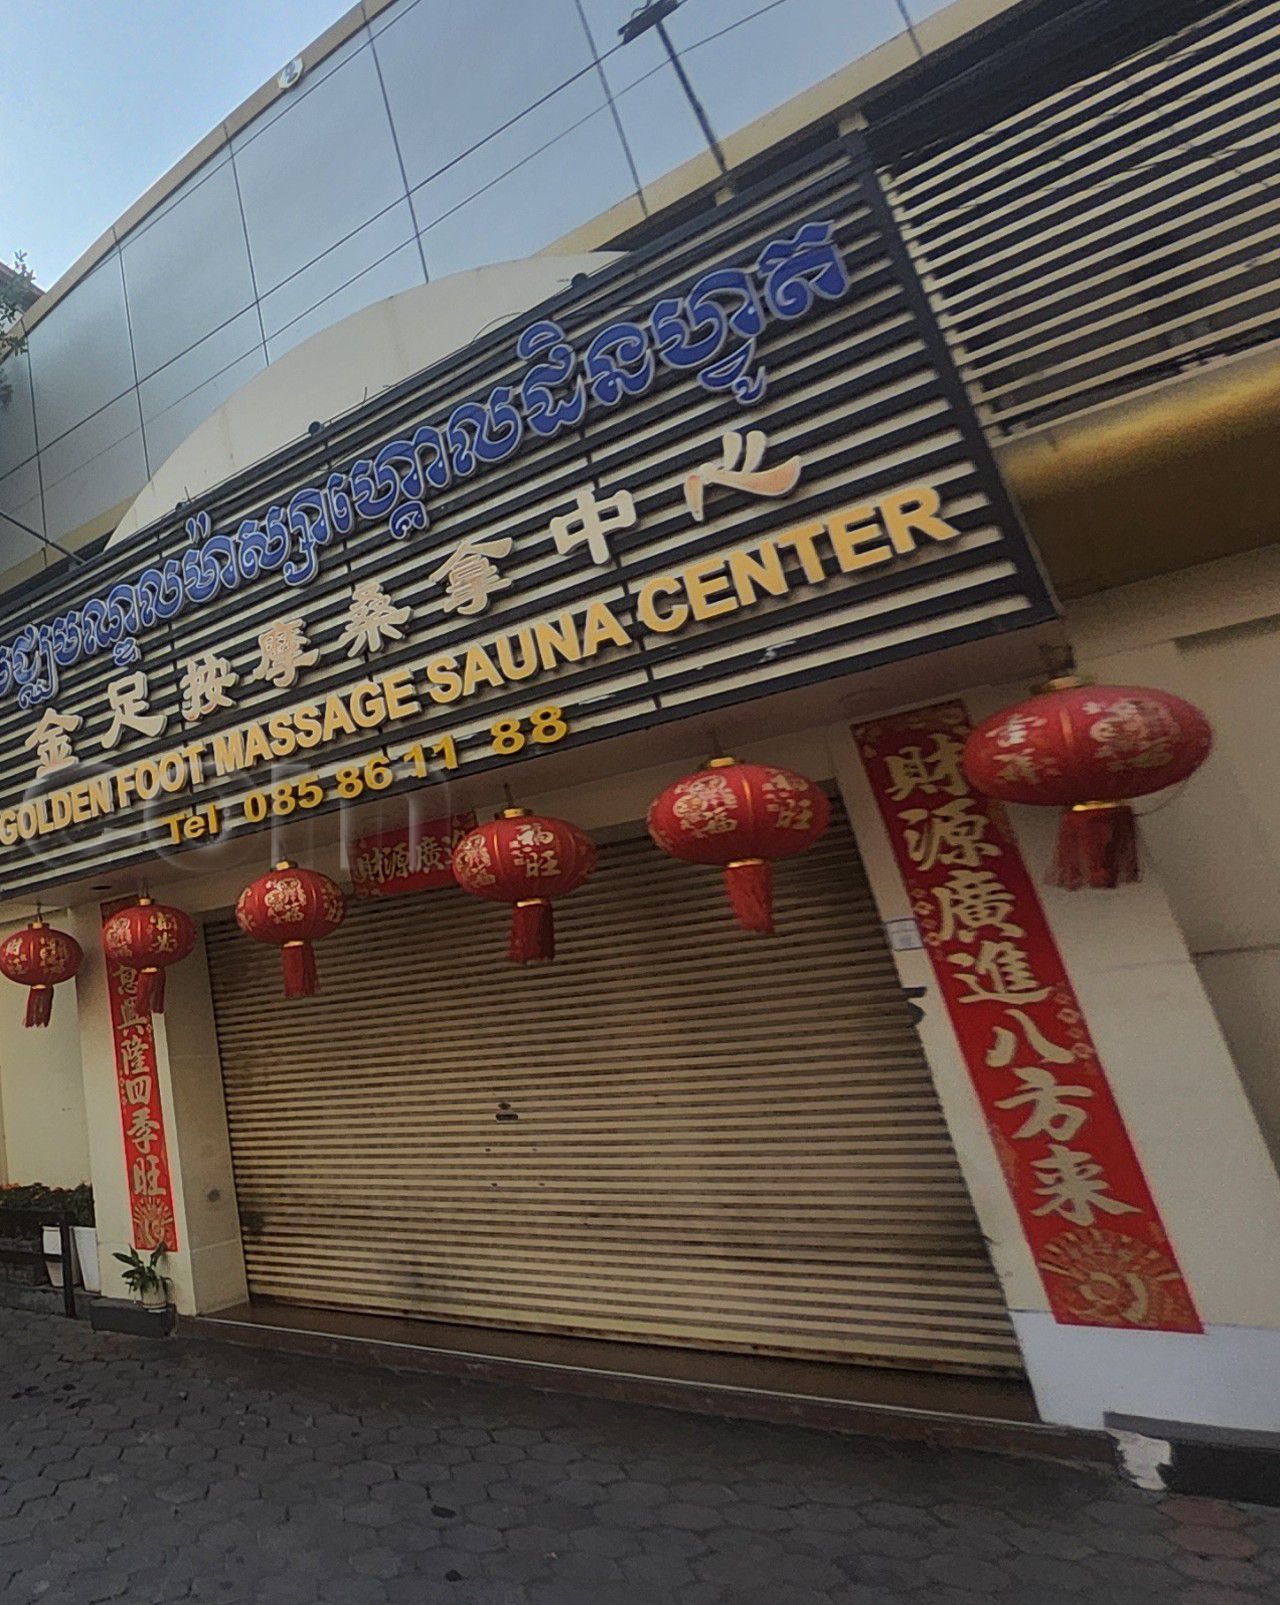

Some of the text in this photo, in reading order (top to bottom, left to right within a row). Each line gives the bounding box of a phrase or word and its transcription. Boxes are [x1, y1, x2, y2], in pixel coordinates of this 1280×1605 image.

[24, 429, 802, 779] 金足按摩桑拿中心
[119, 744, 207, 801] FOOT
[216, 669, 421, 777] MASSAGE
[426, 601, 632, 705] SAUNA
[637, 484, 961, 634] CENTER
[160, 705, 568, 851] Tel 085 86 11 88
